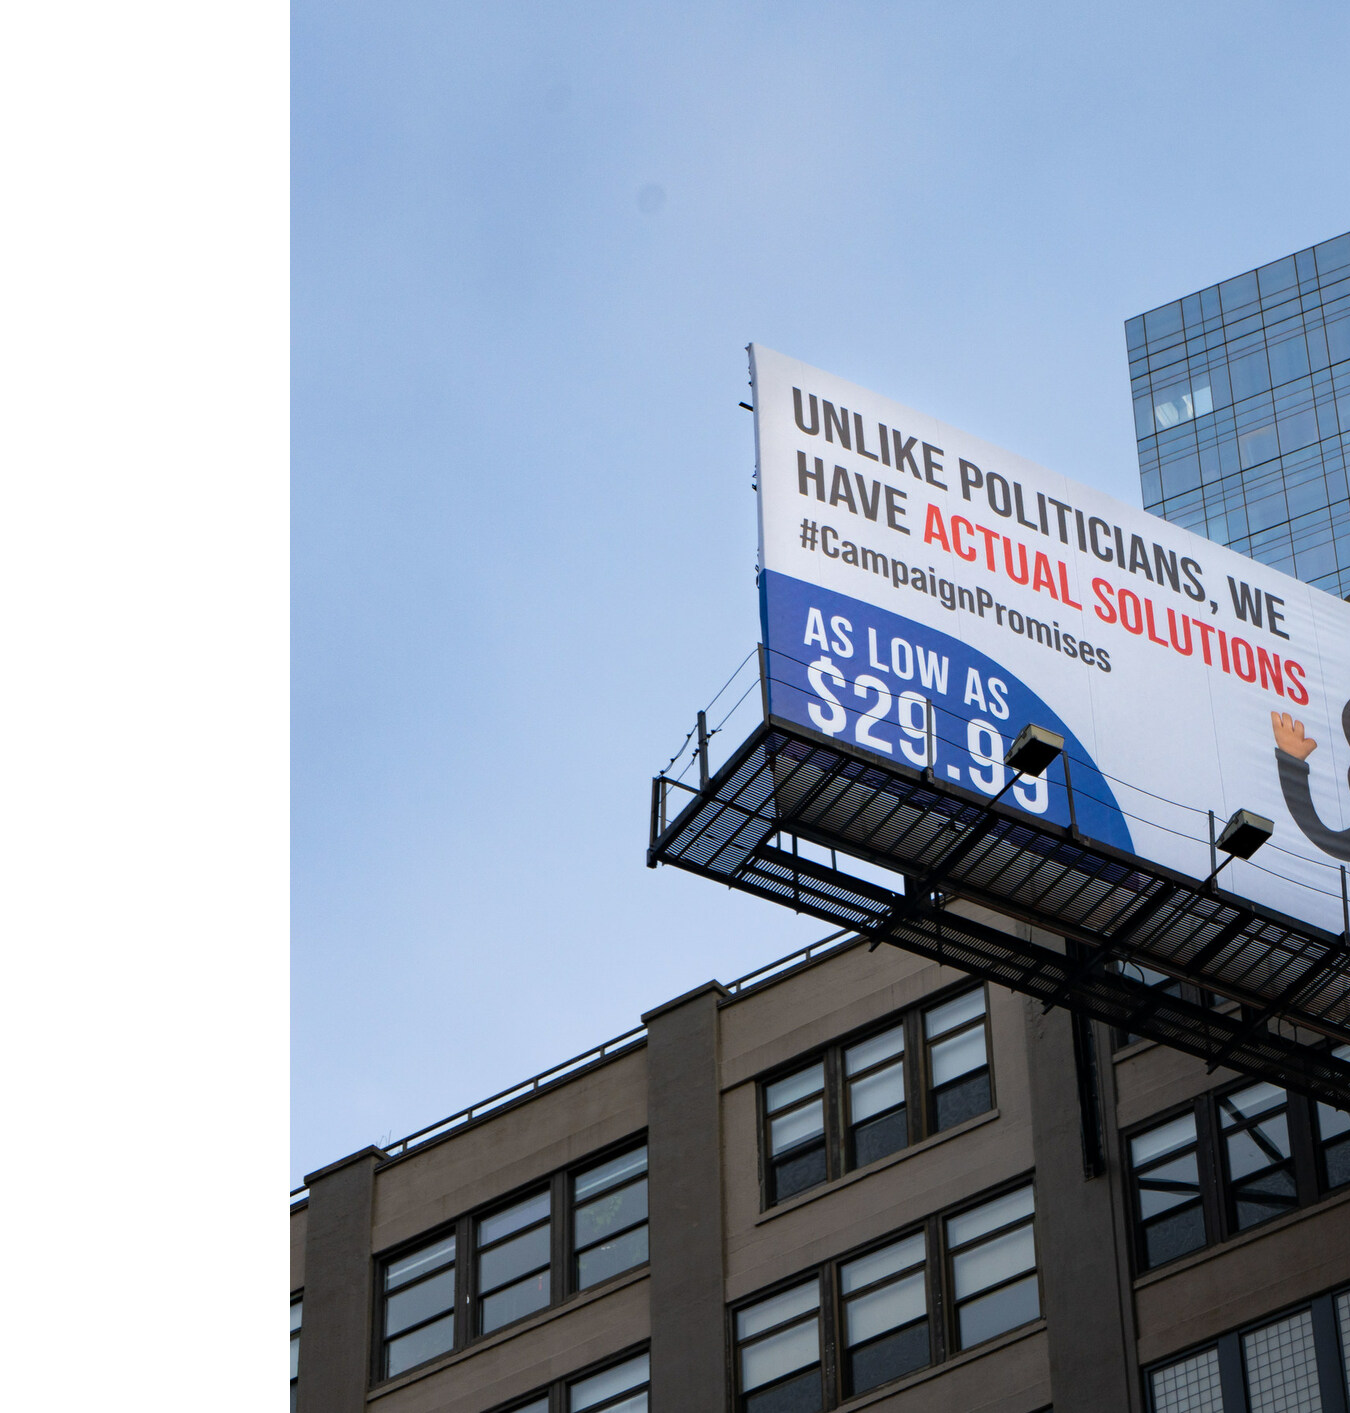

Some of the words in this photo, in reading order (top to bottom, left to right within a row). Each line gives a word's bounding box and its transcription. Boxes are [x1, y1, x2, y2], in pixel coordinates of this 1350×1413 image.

[792, 386, 948, 492] UNLIKE
[958, 457, 1219, 615] POLITICIANS,
[1226, 575, 1290, 641] WE
[796, 450, 911, 536] HAVE
[923, 502, 1083, 612] ACTUAL
[1091, 577, 1310, 706] SOLUTIONS
[799, 518, 1112, 673] #CampaignPromises
[803, 607, 854, 658] AS
[868, 627, 949, 695] LOW
[964, 667, 1010, 720] AS
[807, 655, 1049, 814] $29.99
